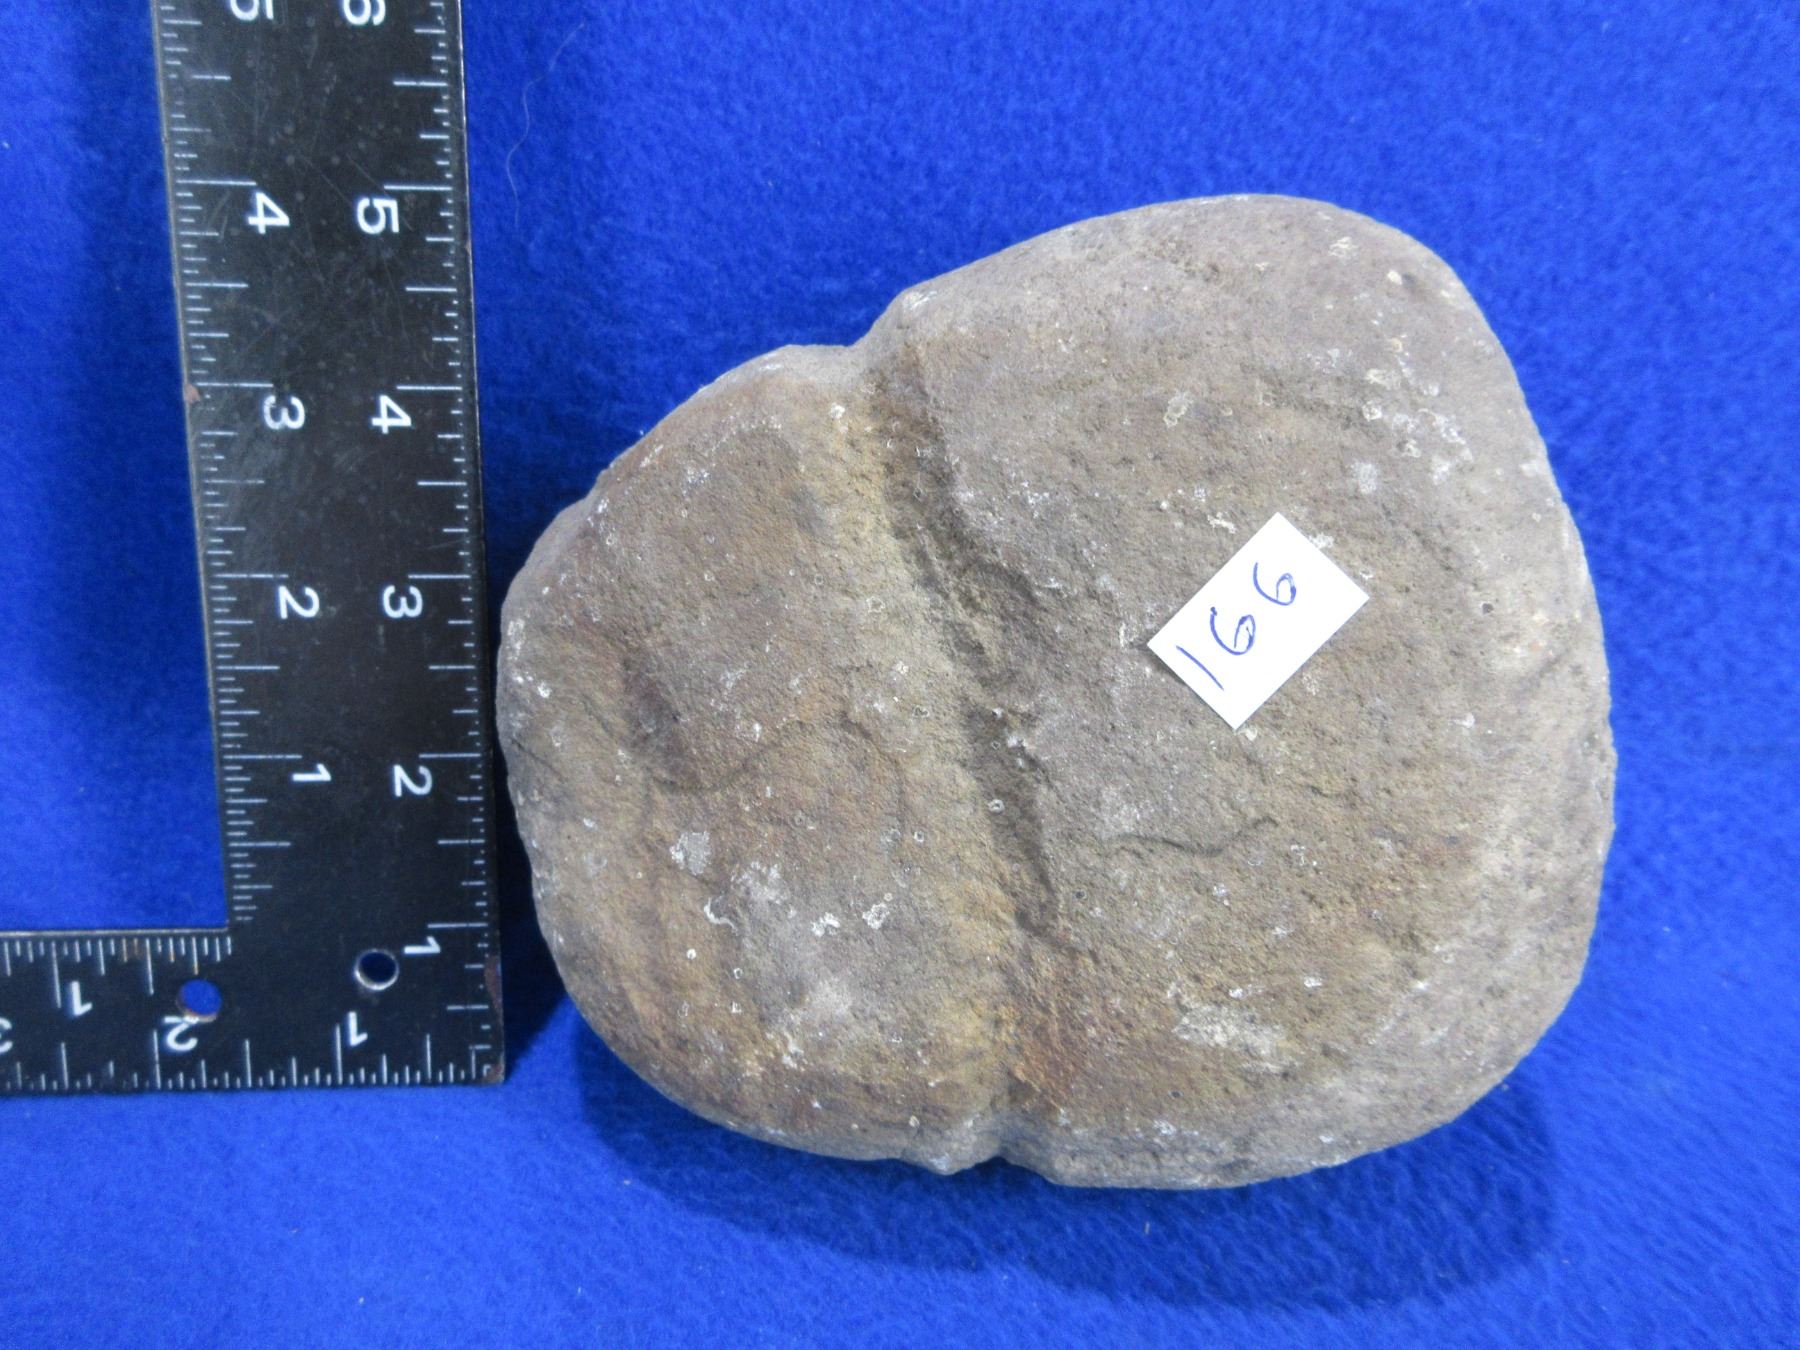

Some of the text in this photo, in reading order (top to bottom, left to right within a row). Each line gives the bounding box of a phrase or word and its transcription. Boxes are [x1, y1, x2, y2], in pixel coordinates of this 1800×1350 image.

[343, 0, 386, 26] 6
[247, 191, 291, 235] 4
[357, 197, 400, 235] 5
[263, 394, 306, 431] 3
[371, 395, 412, 435] 4
[278, 585, 321, 620] 2
[383, 585, 423, 619] 3
[1176, 562, 1297, 691] 166
[292, 764, 332, 783] 1
[394, 765, 433, 797] 2
[404, 937, 441, 956] 1
[70, 981, 93, 1017] 1
[164, 1015, 199, 1052] 2
[347, 1012, 369, 1047] 1
